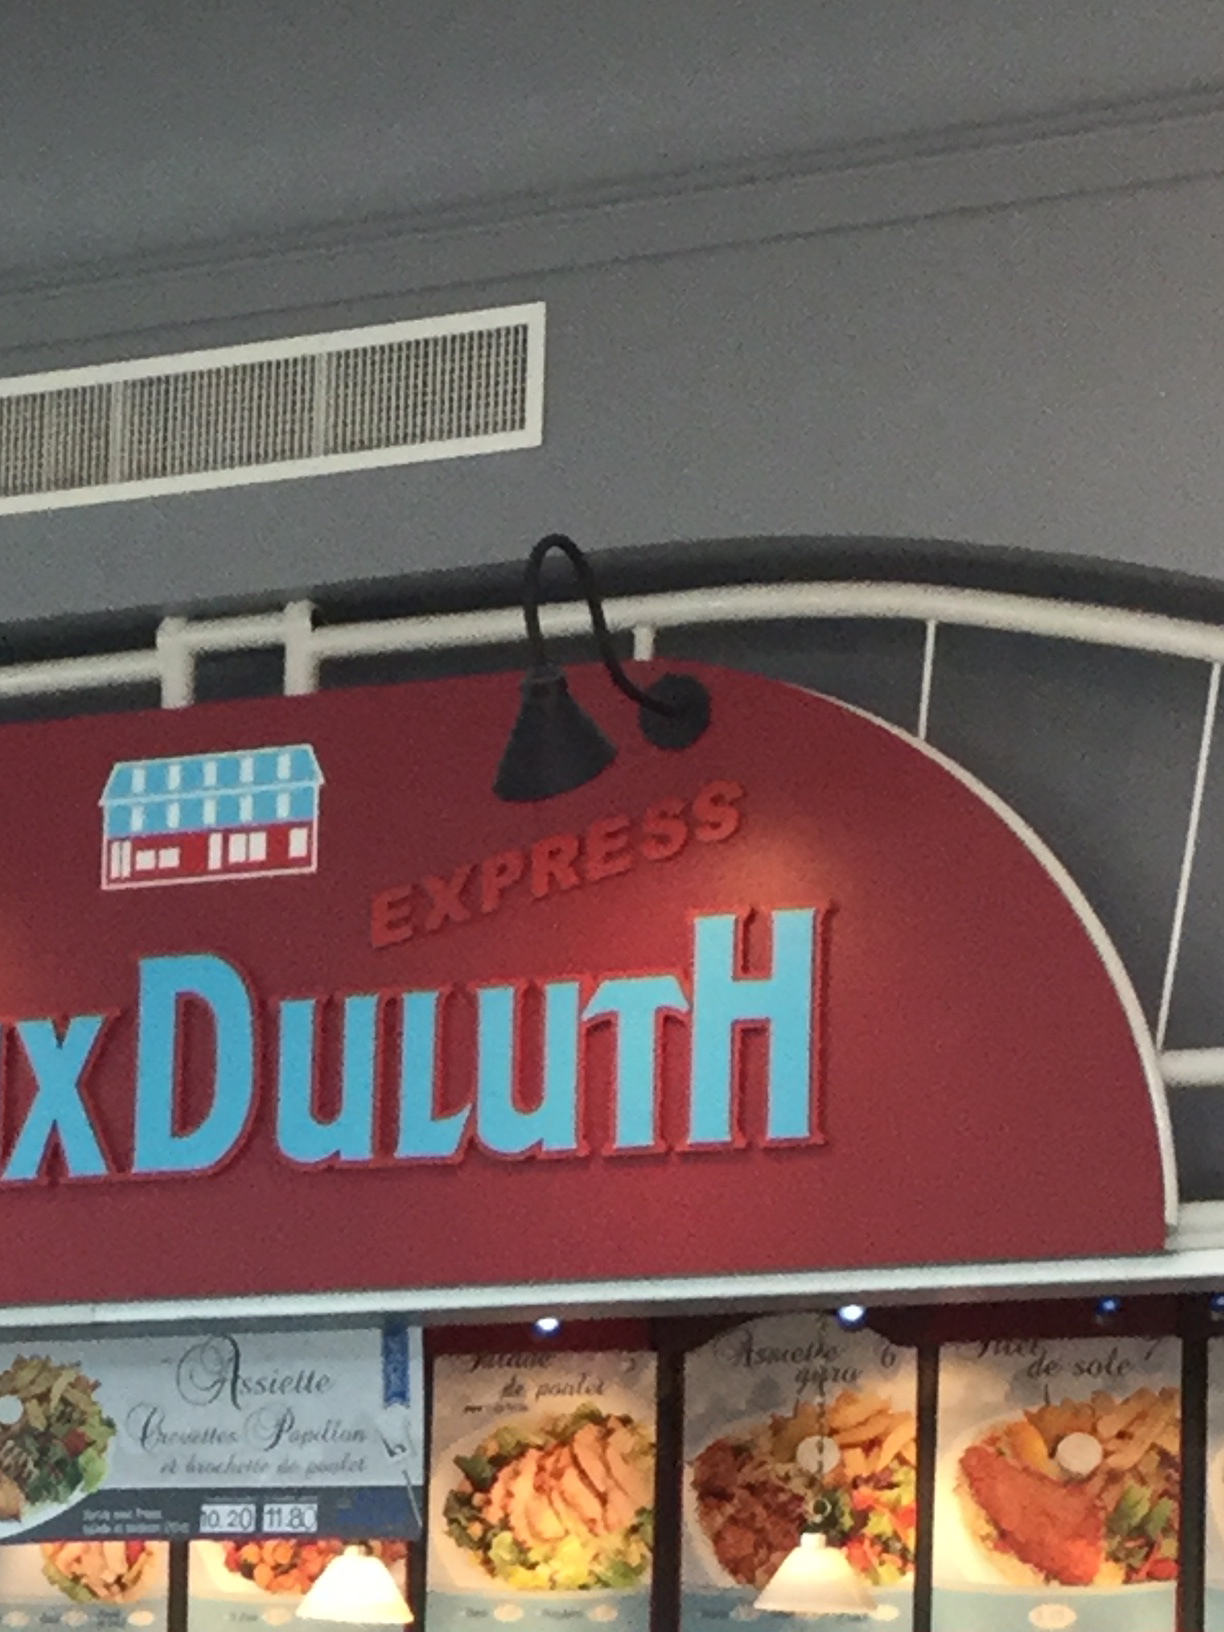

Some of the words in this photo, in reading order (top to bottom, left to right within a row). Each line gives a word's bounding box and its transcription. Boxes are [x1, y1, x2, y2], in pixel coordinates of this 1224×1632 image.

[373, 780, 747, 949] EXPRESS
[175, 1335, 330, 1411] Assiette
[1025, 1347, 1062, 1380] de
[1070, 1345, 1134, 1377] sole
[243, 1402, 368, 1452] Papillon
